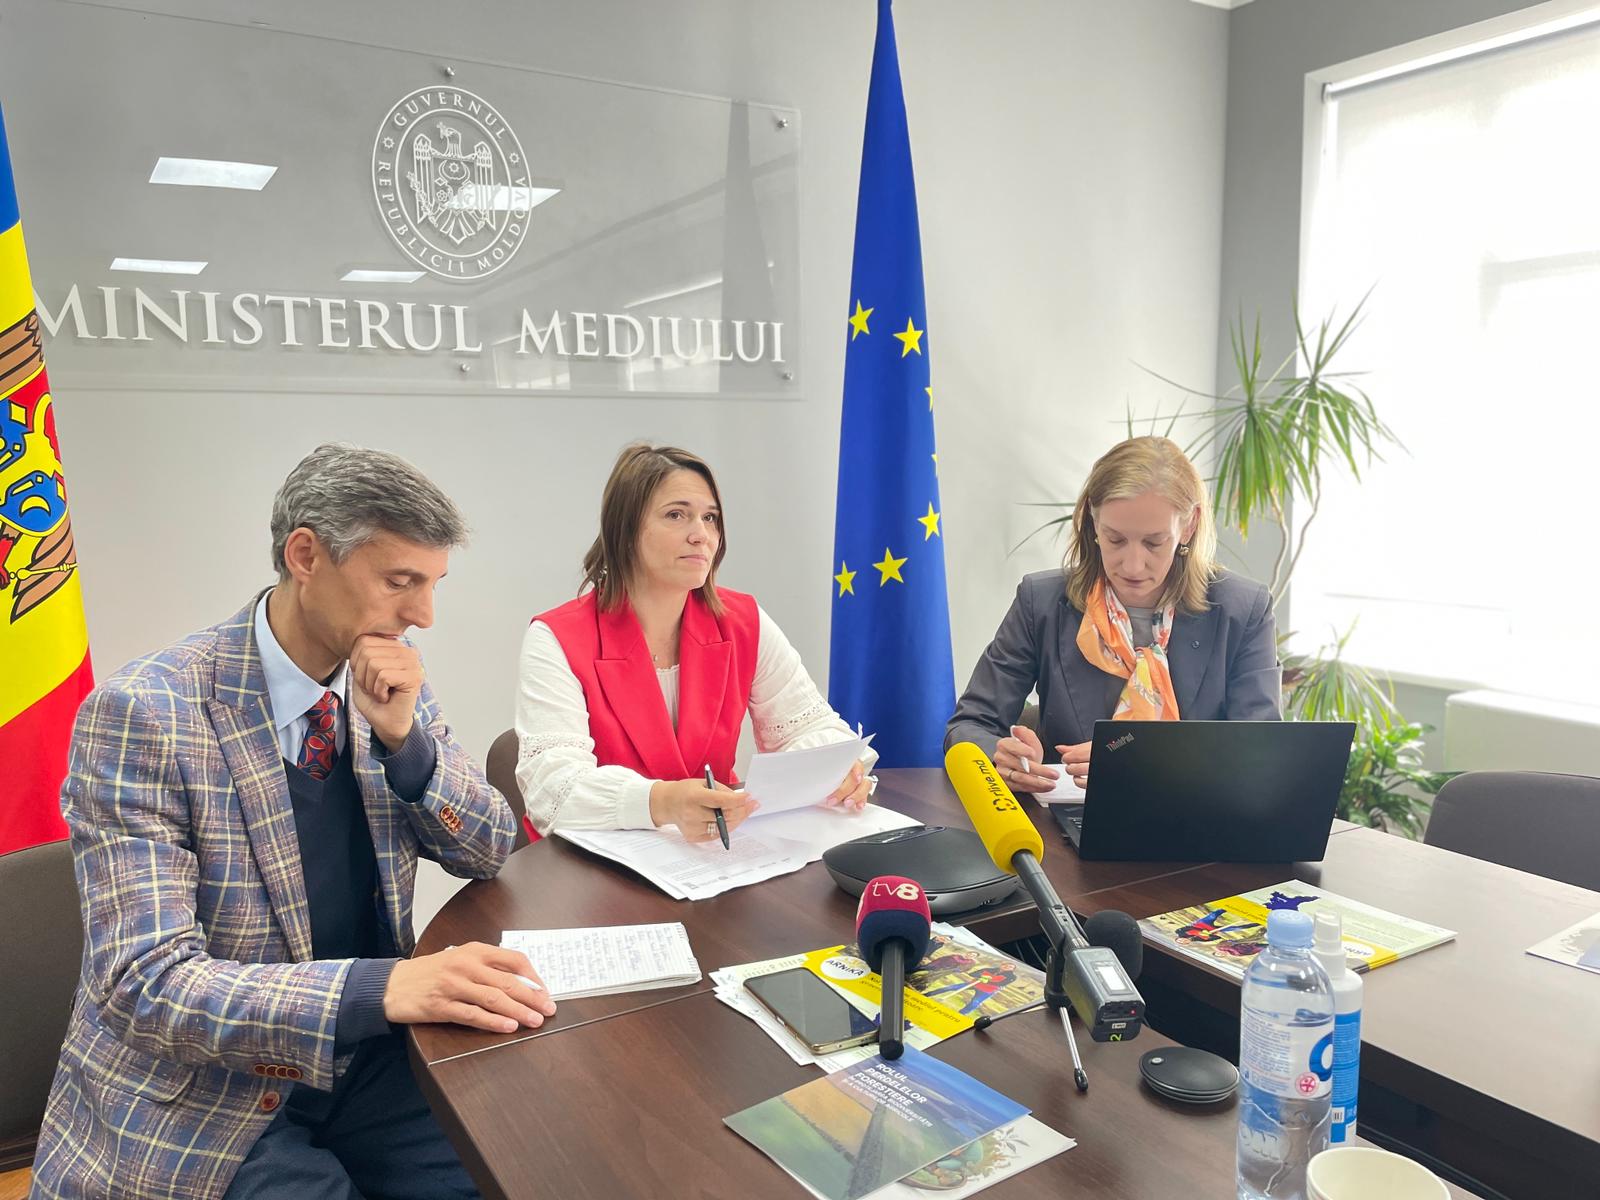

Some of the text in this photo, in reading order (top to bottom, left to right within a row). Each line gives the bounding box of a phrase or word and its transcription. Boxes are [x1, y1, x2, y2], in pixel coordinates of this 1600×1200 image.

[393, 92, 506, 140] GUVERNUL
[378, 161, 527, 274] REPUBLICII MOLDOVA
[33, 283, 786, 363] MINISTERUL MEDIULUI
[1106, 732, 1135, 752] ThinkPad
[825, 958, 865, 976] ARNIKA
[855, 1072, 913, 1106] FORESTIERE
[864, 1068, 927, 1104] PERDELELOR
[876, 1063, 907, 1082] ROLUL
